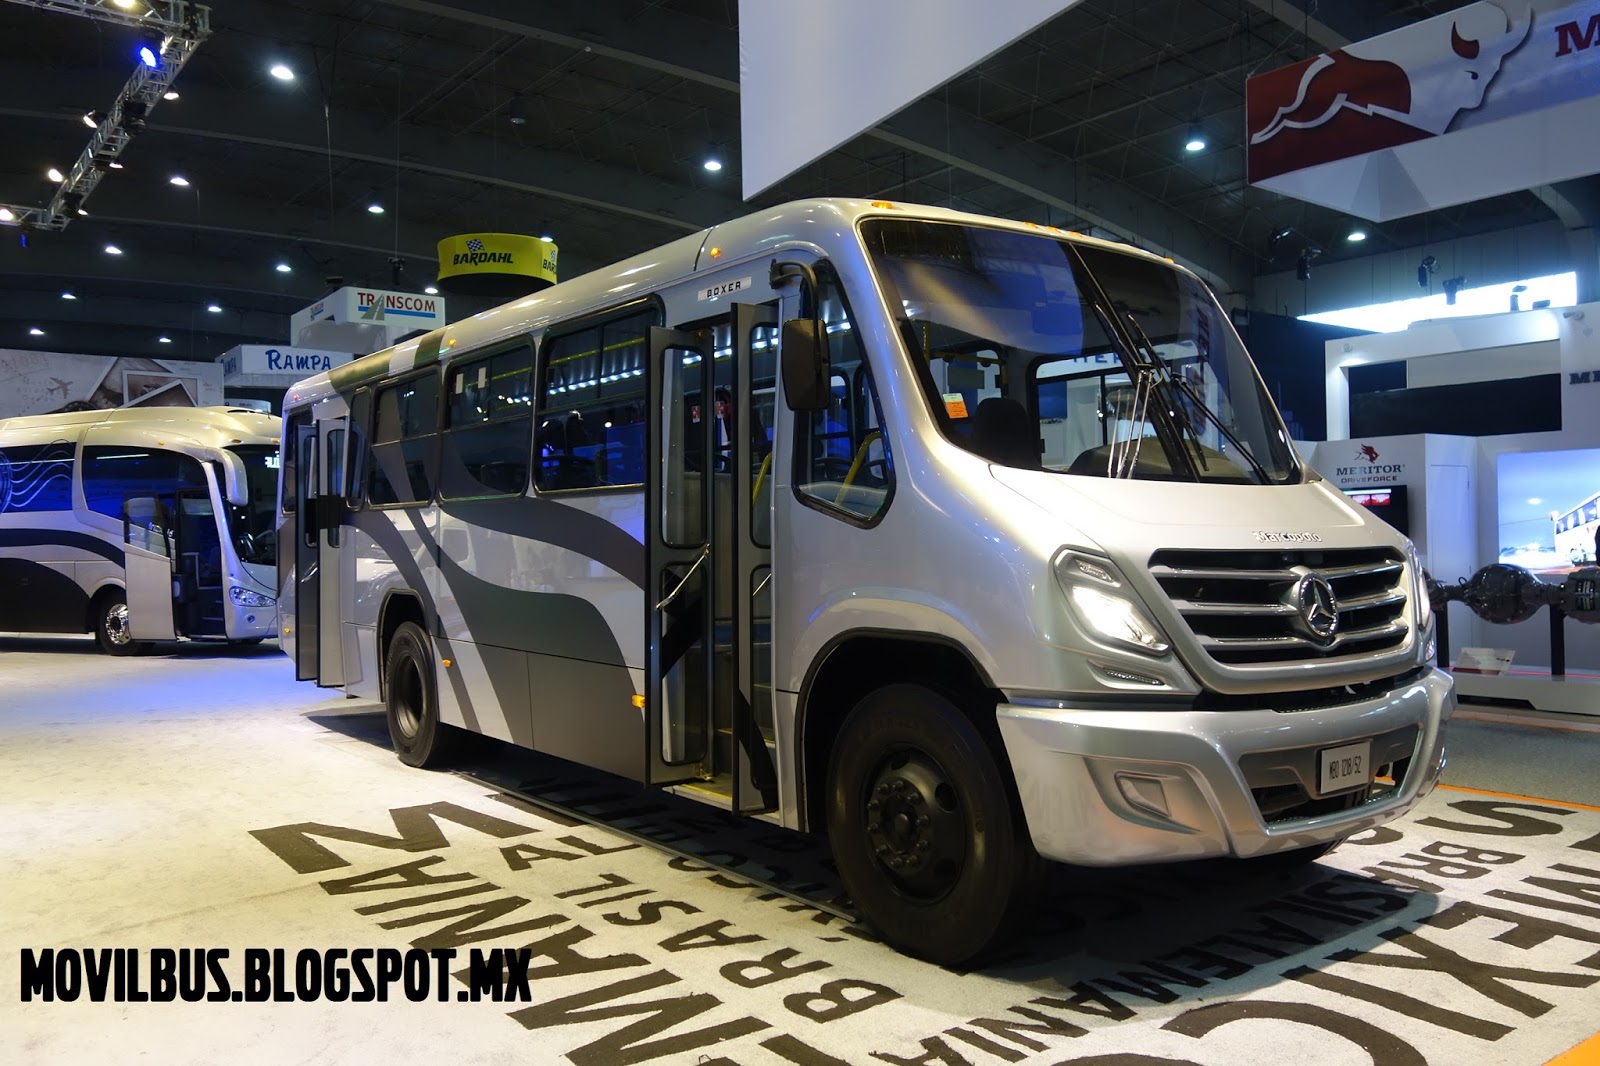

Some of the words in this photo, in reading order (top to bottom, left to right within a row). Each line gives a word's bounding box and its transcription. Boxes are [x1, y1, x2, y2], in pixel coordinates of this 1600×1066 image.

[453, 251, 514, 266] BARDAHL
[706, 281, 742, 298] BOXER
[357, 292, 436, 313] TRANSCOM
[265, 349, 331, 371] RAMPA
[1336, 464, 1402, 476] MERITOR
[1341, 475, 1398, 484] DRIVEFORCE
[1252, 531, 1322, 543] Marcopolo
[553, 873, 905, 1024] BRASIL
